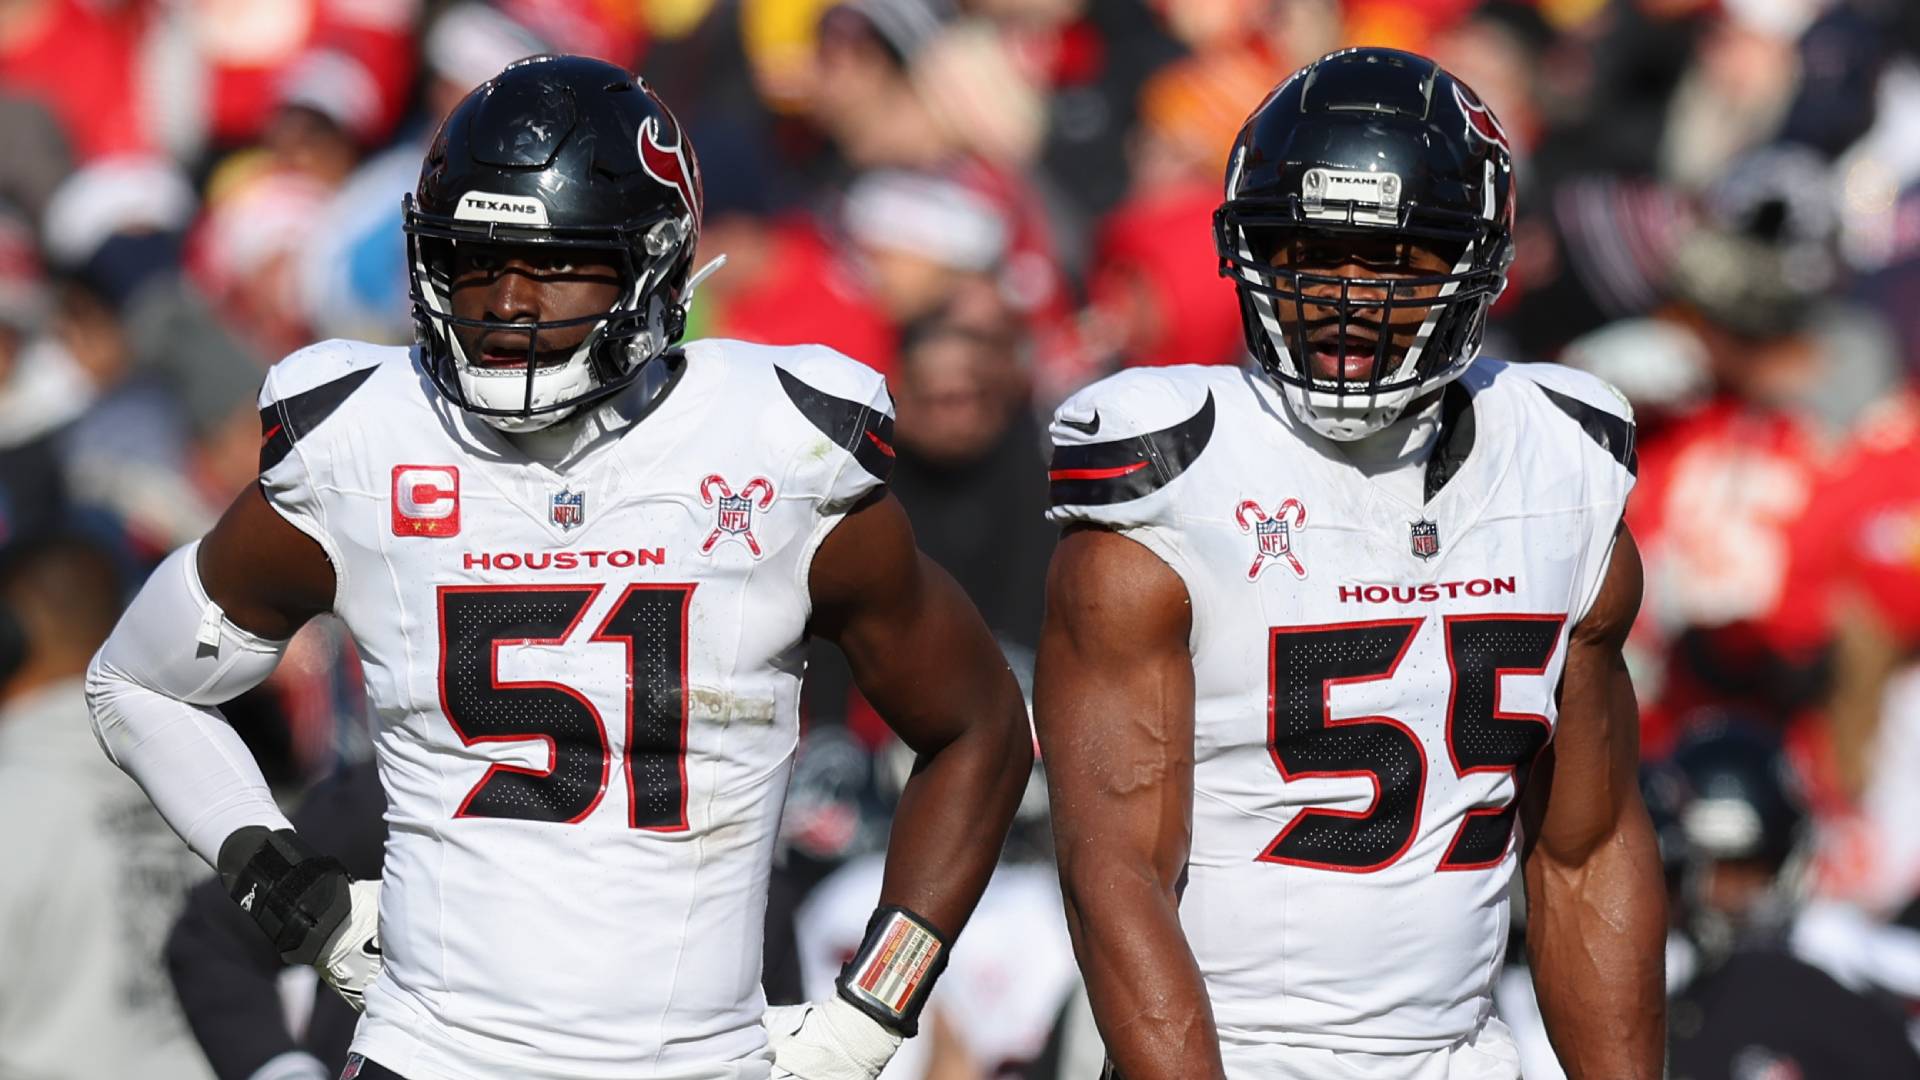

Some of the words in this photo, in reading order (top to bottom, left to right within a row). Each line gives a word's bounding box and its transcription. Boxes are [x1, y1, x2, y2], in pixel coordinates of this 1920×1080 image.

[1329, 176, 1378, 185] TEXANS
[465, 198, 537, 214] TEXANS
[397, 469, 455, 519] C
[553, 506, 580, 525] NFL
[721, 510, 748, 530] NFL
[1260, 534, 1288, 553] NFL
[1414, 536, 1438, 552] NFL
[463, 547, 666, 571] HOUSTON
[1338, 576, 1516, 604] HOUSTON
[436, 582, 700, 833] 51
[1253, 613, 1569, 875] 55
